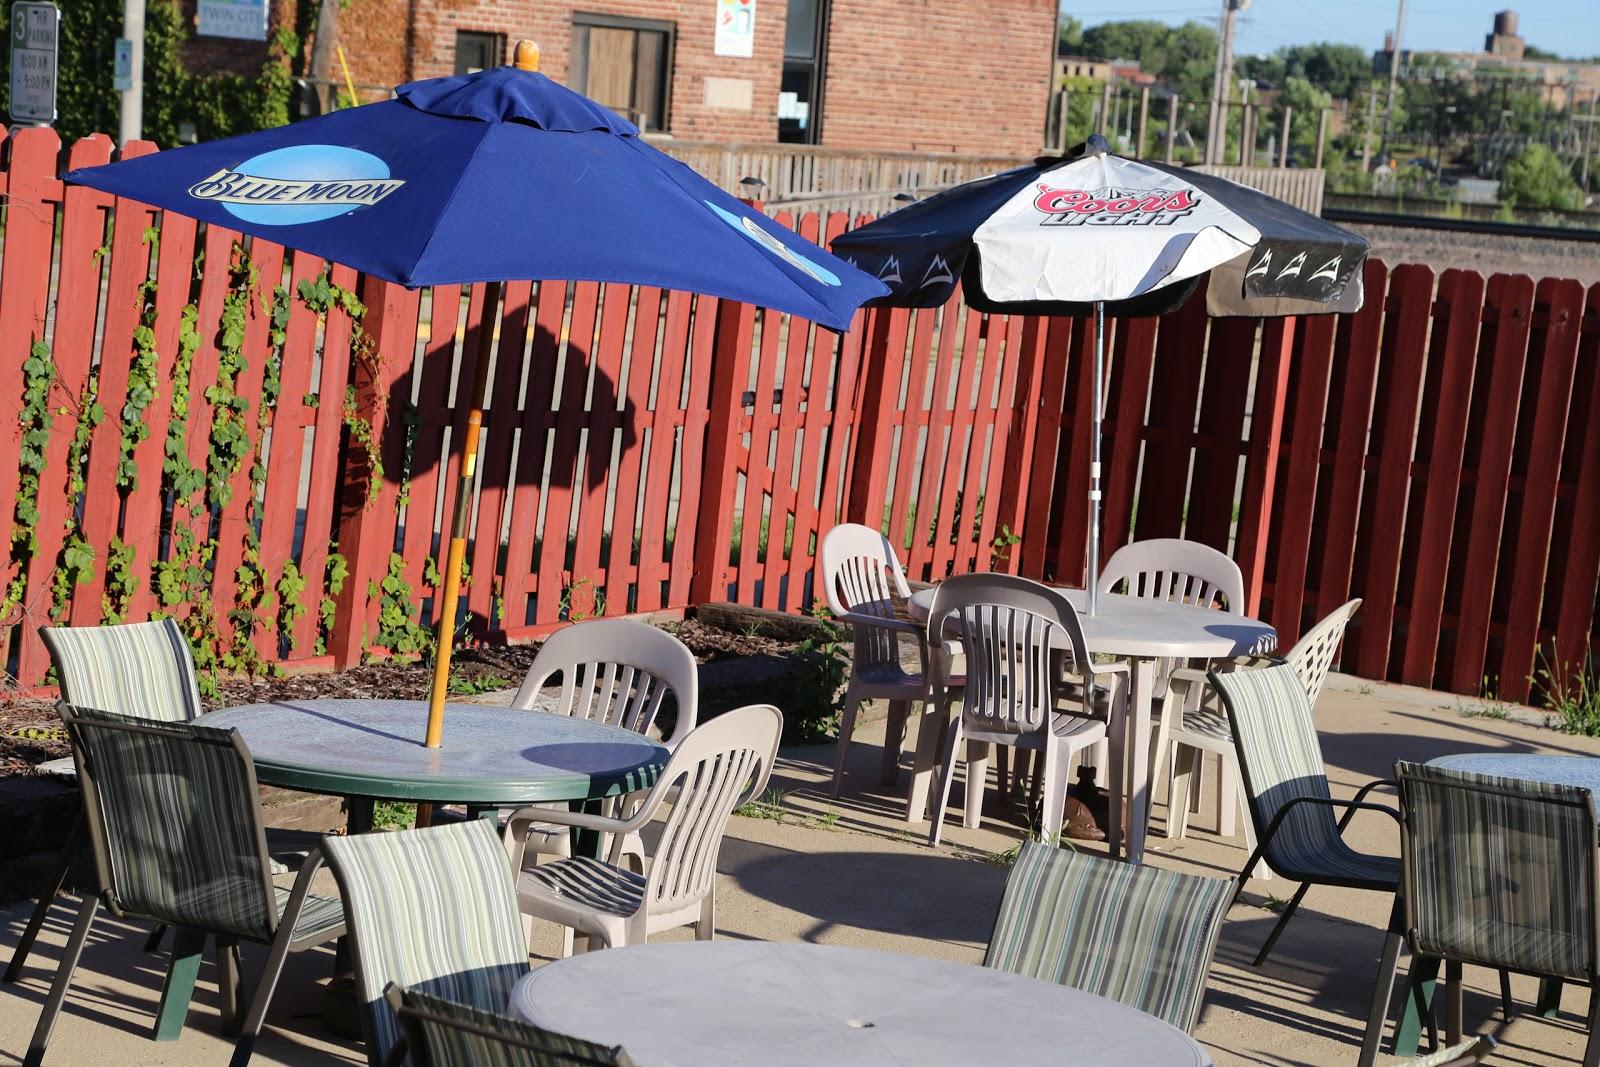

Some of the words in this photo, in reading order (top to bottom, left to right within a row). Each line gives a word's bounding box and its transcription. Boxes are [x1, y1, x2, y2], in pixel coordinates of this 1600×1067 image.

[202, 6, 234, 21] TWIN
[236, 9, 264, 24] CITY
[15, 11, 26, 41] 3
[36, 12, 48, 25] HR
[28, 29, 54, 43] PARKING
[38, 56, 48, 70] AM
[41, 76, 51, 90] PM
[190, 172, 299, 201] BLUE
[293, 182, 396, 201] MOON
[1034, 183, 1199, 214] Coors
[1040, 211, 1193, 227] LIGHT
